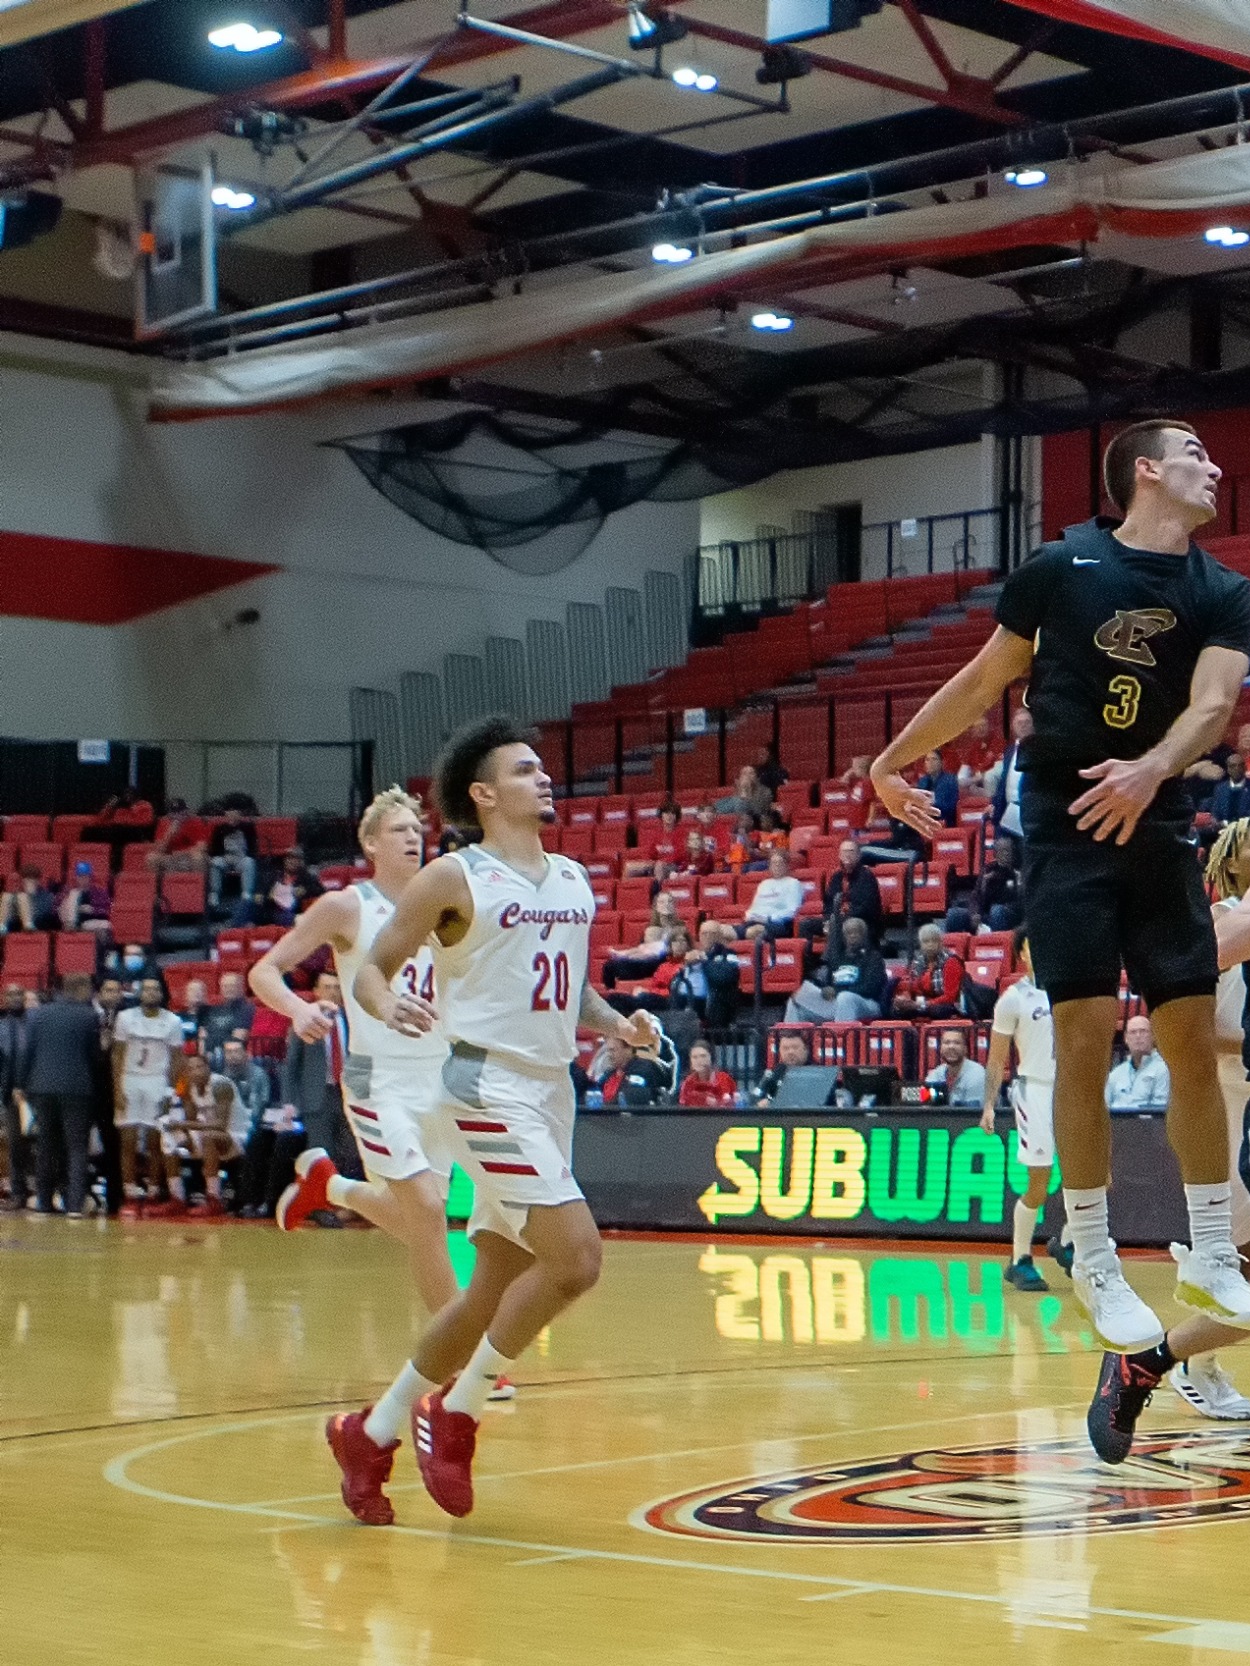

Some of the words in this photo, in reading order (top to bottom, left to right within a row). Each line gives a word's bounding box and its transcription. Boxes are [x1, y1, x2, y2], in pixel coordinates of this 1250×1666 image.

[1102, 674, 1141, 729] 3
[499, 902, 588, 941] Cougars
[403, 963, 434, 1003] 34
[532, 951, 569, 1012] 20
